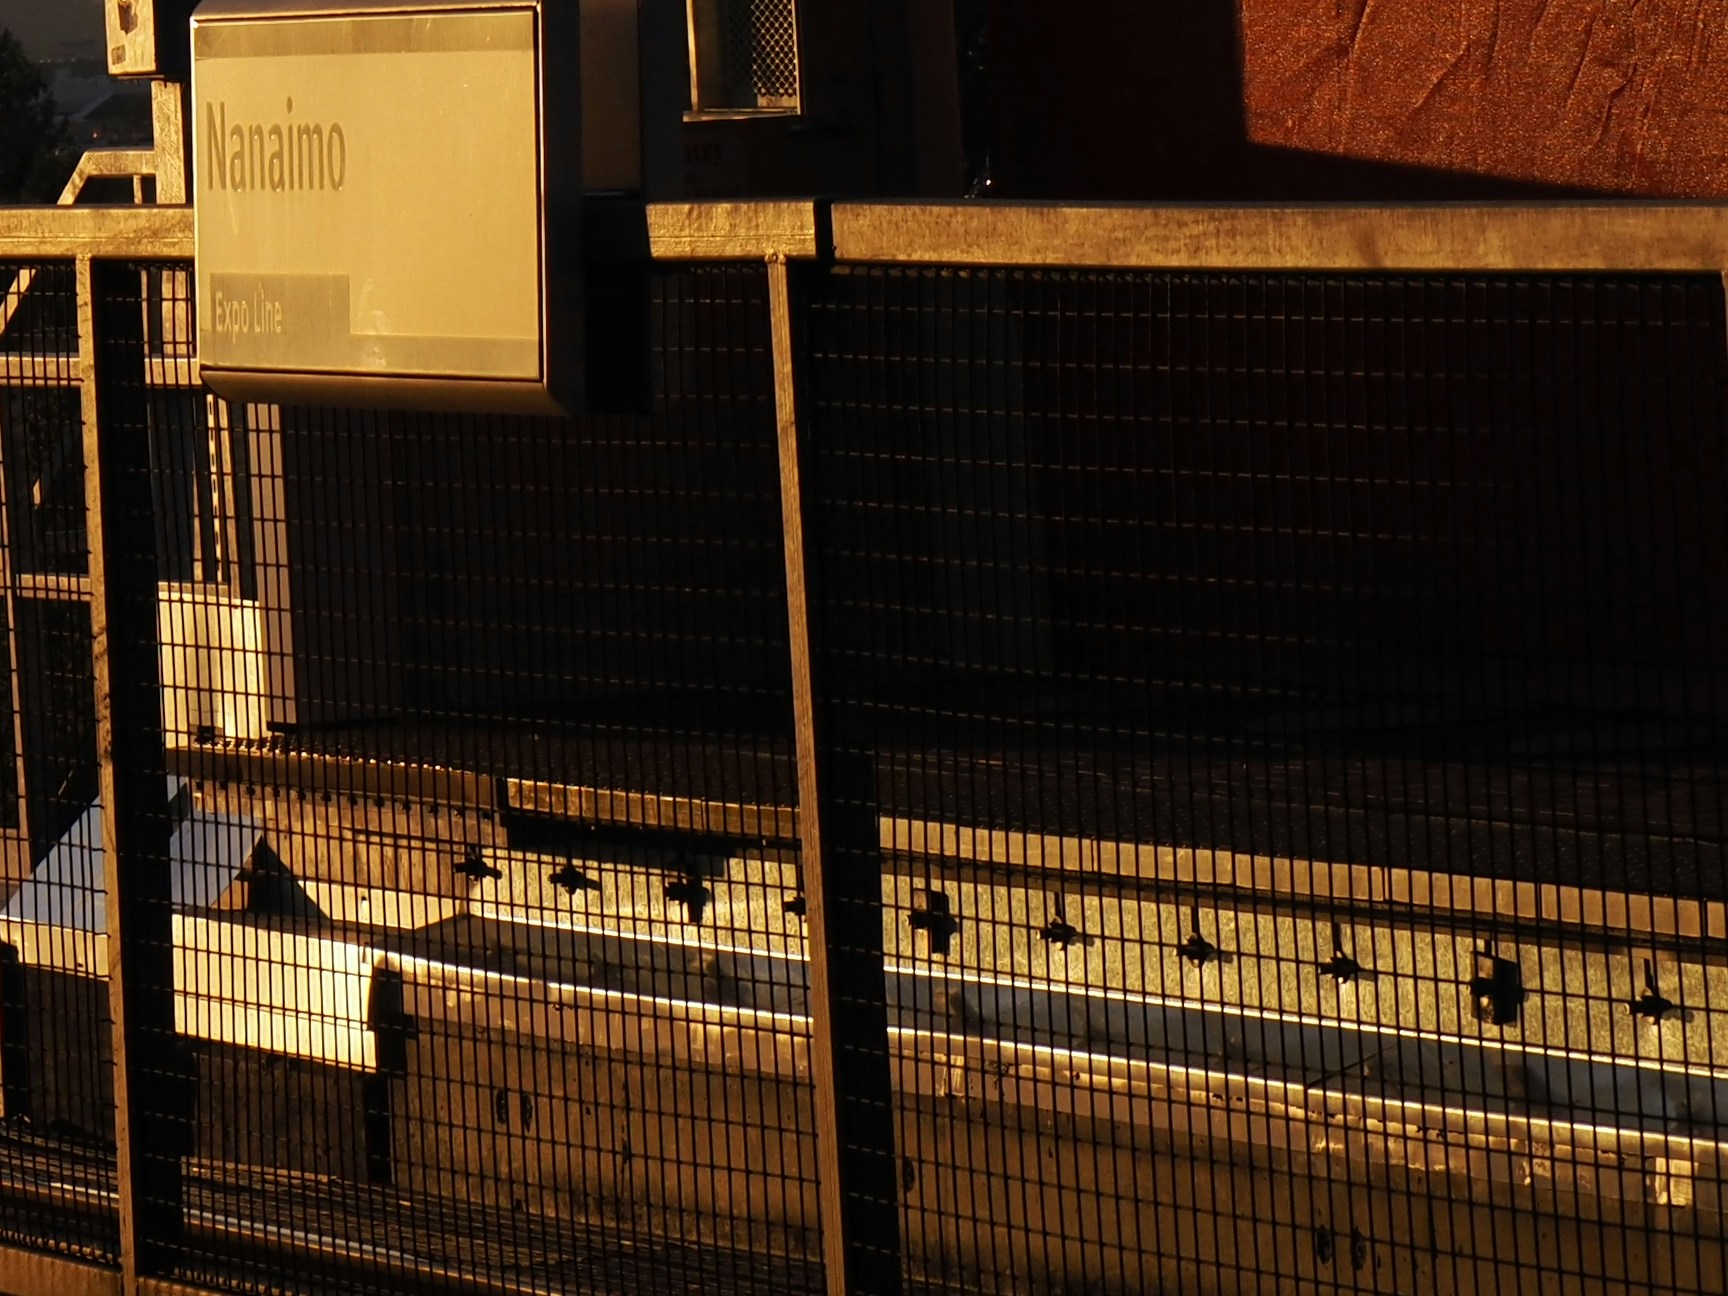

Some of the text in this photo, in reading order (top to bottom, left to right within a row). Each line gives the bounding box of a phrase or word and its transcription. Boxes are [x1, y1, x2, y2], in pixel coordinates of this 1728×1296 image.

[205, 96, 345, 193] Nanaimo
[215, 282, 282, 344] Expo Line
